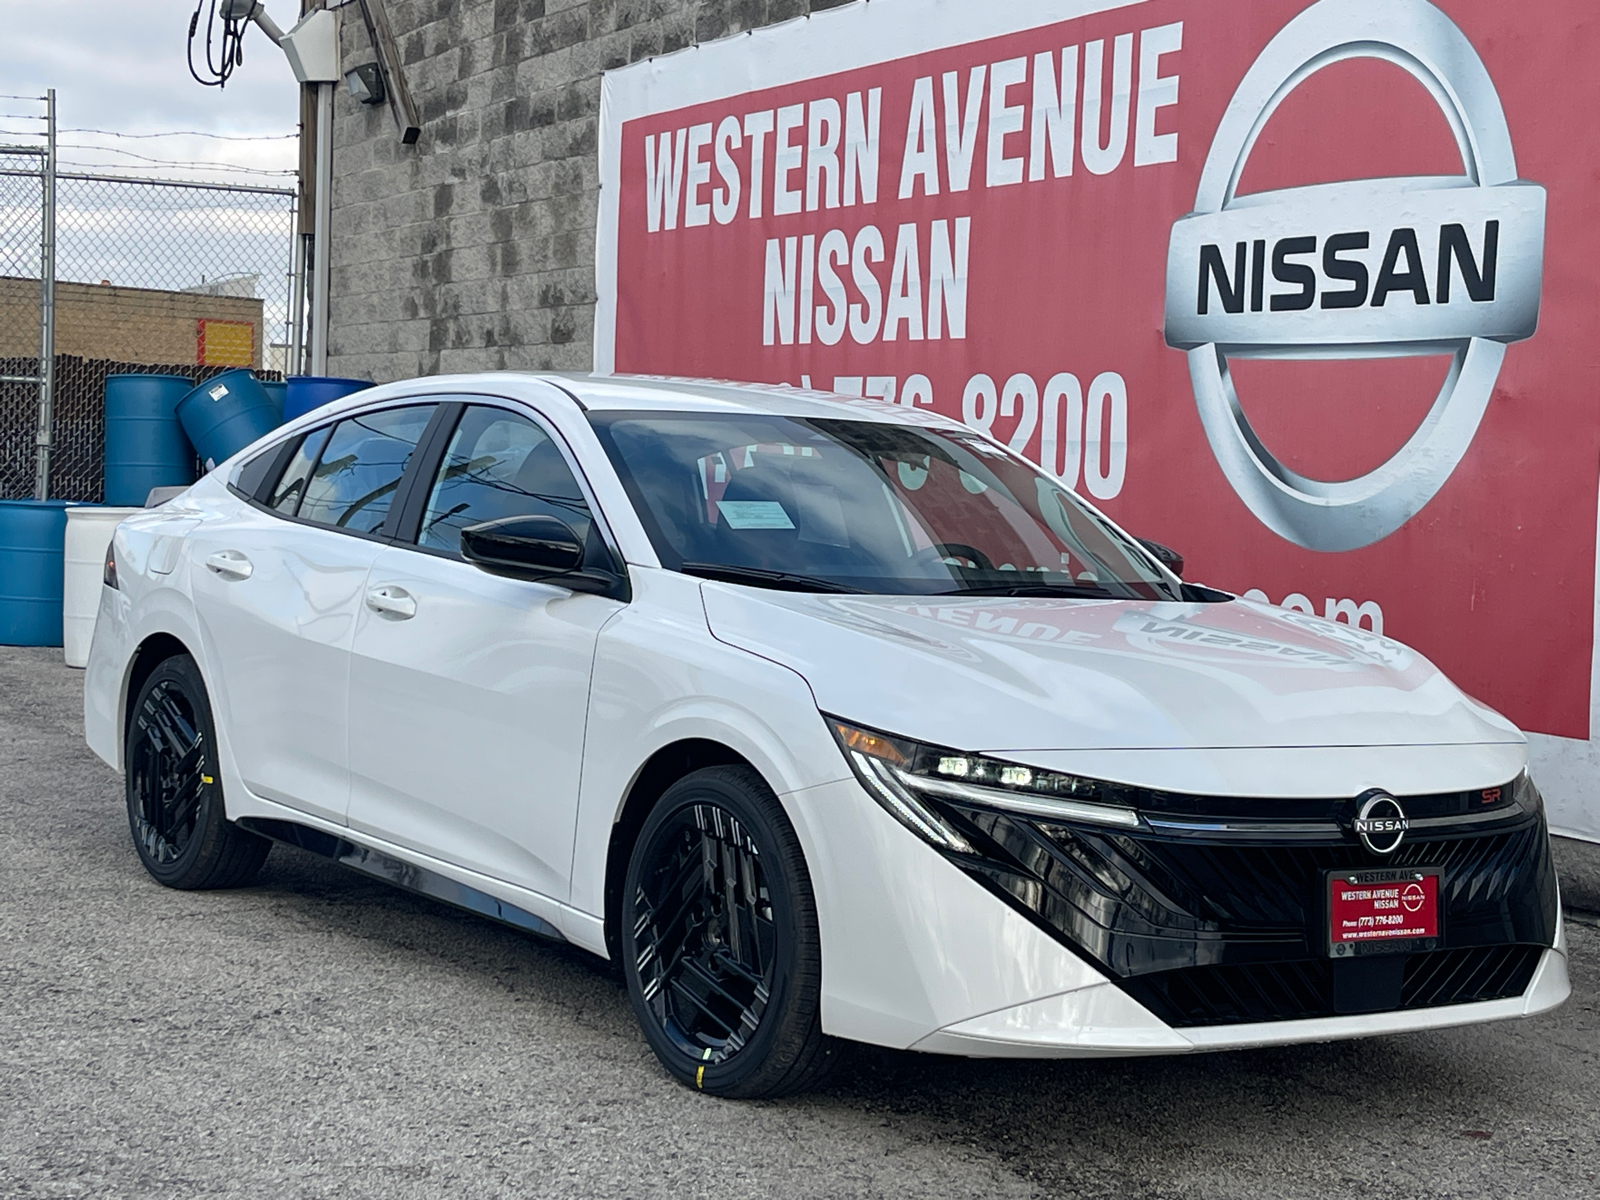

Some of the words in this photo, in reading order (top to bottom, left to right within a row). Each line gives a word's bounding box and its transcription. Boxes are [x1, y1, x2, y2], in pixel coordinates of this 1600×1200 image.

[645, 87, 882, 233] WESTERN
[898, 20, 1184, 200] AVENUE
[1197, 219, 1499, 316] NISSAN
[763, 216, 971, 346] NISSAN
[1481, 788, 1501, 804] SR
[1357, 820, 1409, 831] NISSAN
[1356, 871, 1396, 882] WESTERN
[1341, 890, 1372, 901] WESTERN
[1372, 889, 1399, 899] AVENUE
[1374, 900, 1399, 909] NISSAN
